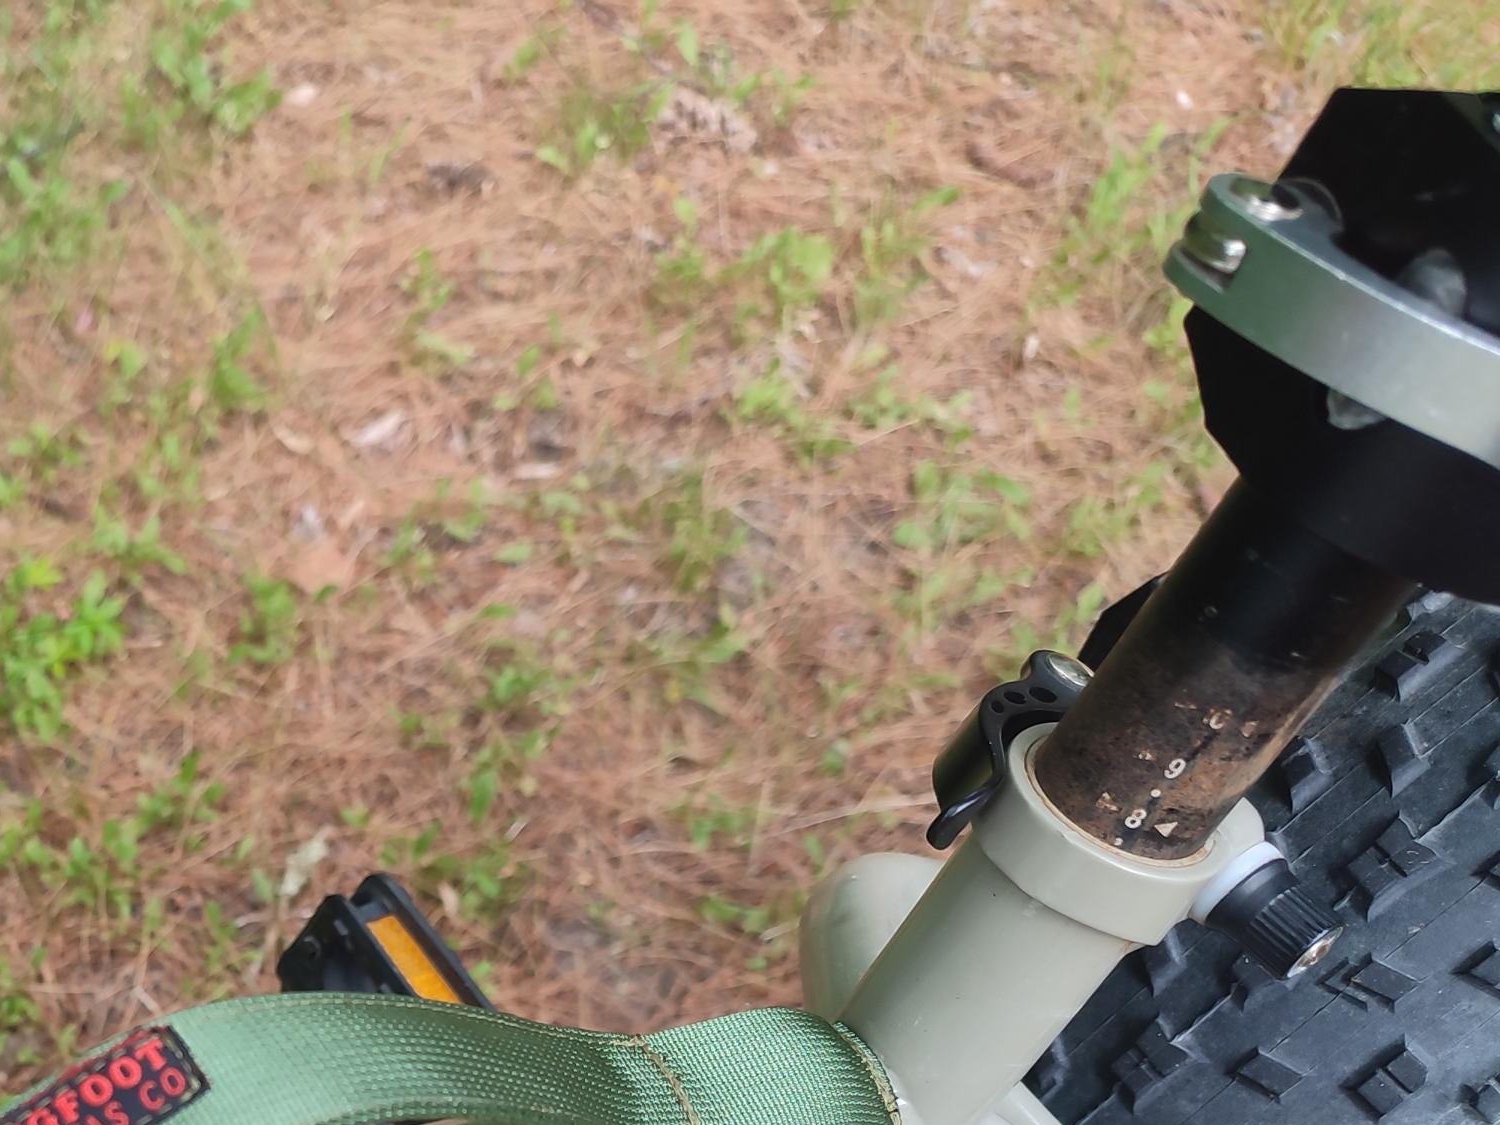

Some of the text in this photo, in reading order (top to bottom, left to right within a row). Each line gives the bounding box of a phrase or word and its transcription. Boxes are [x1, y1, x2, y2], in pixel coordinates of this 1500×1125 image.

[1164, 758, 1186, 779] 9
[1124, 809, 1147, 829] 8
[138, 1066, 186, 1112] CO
